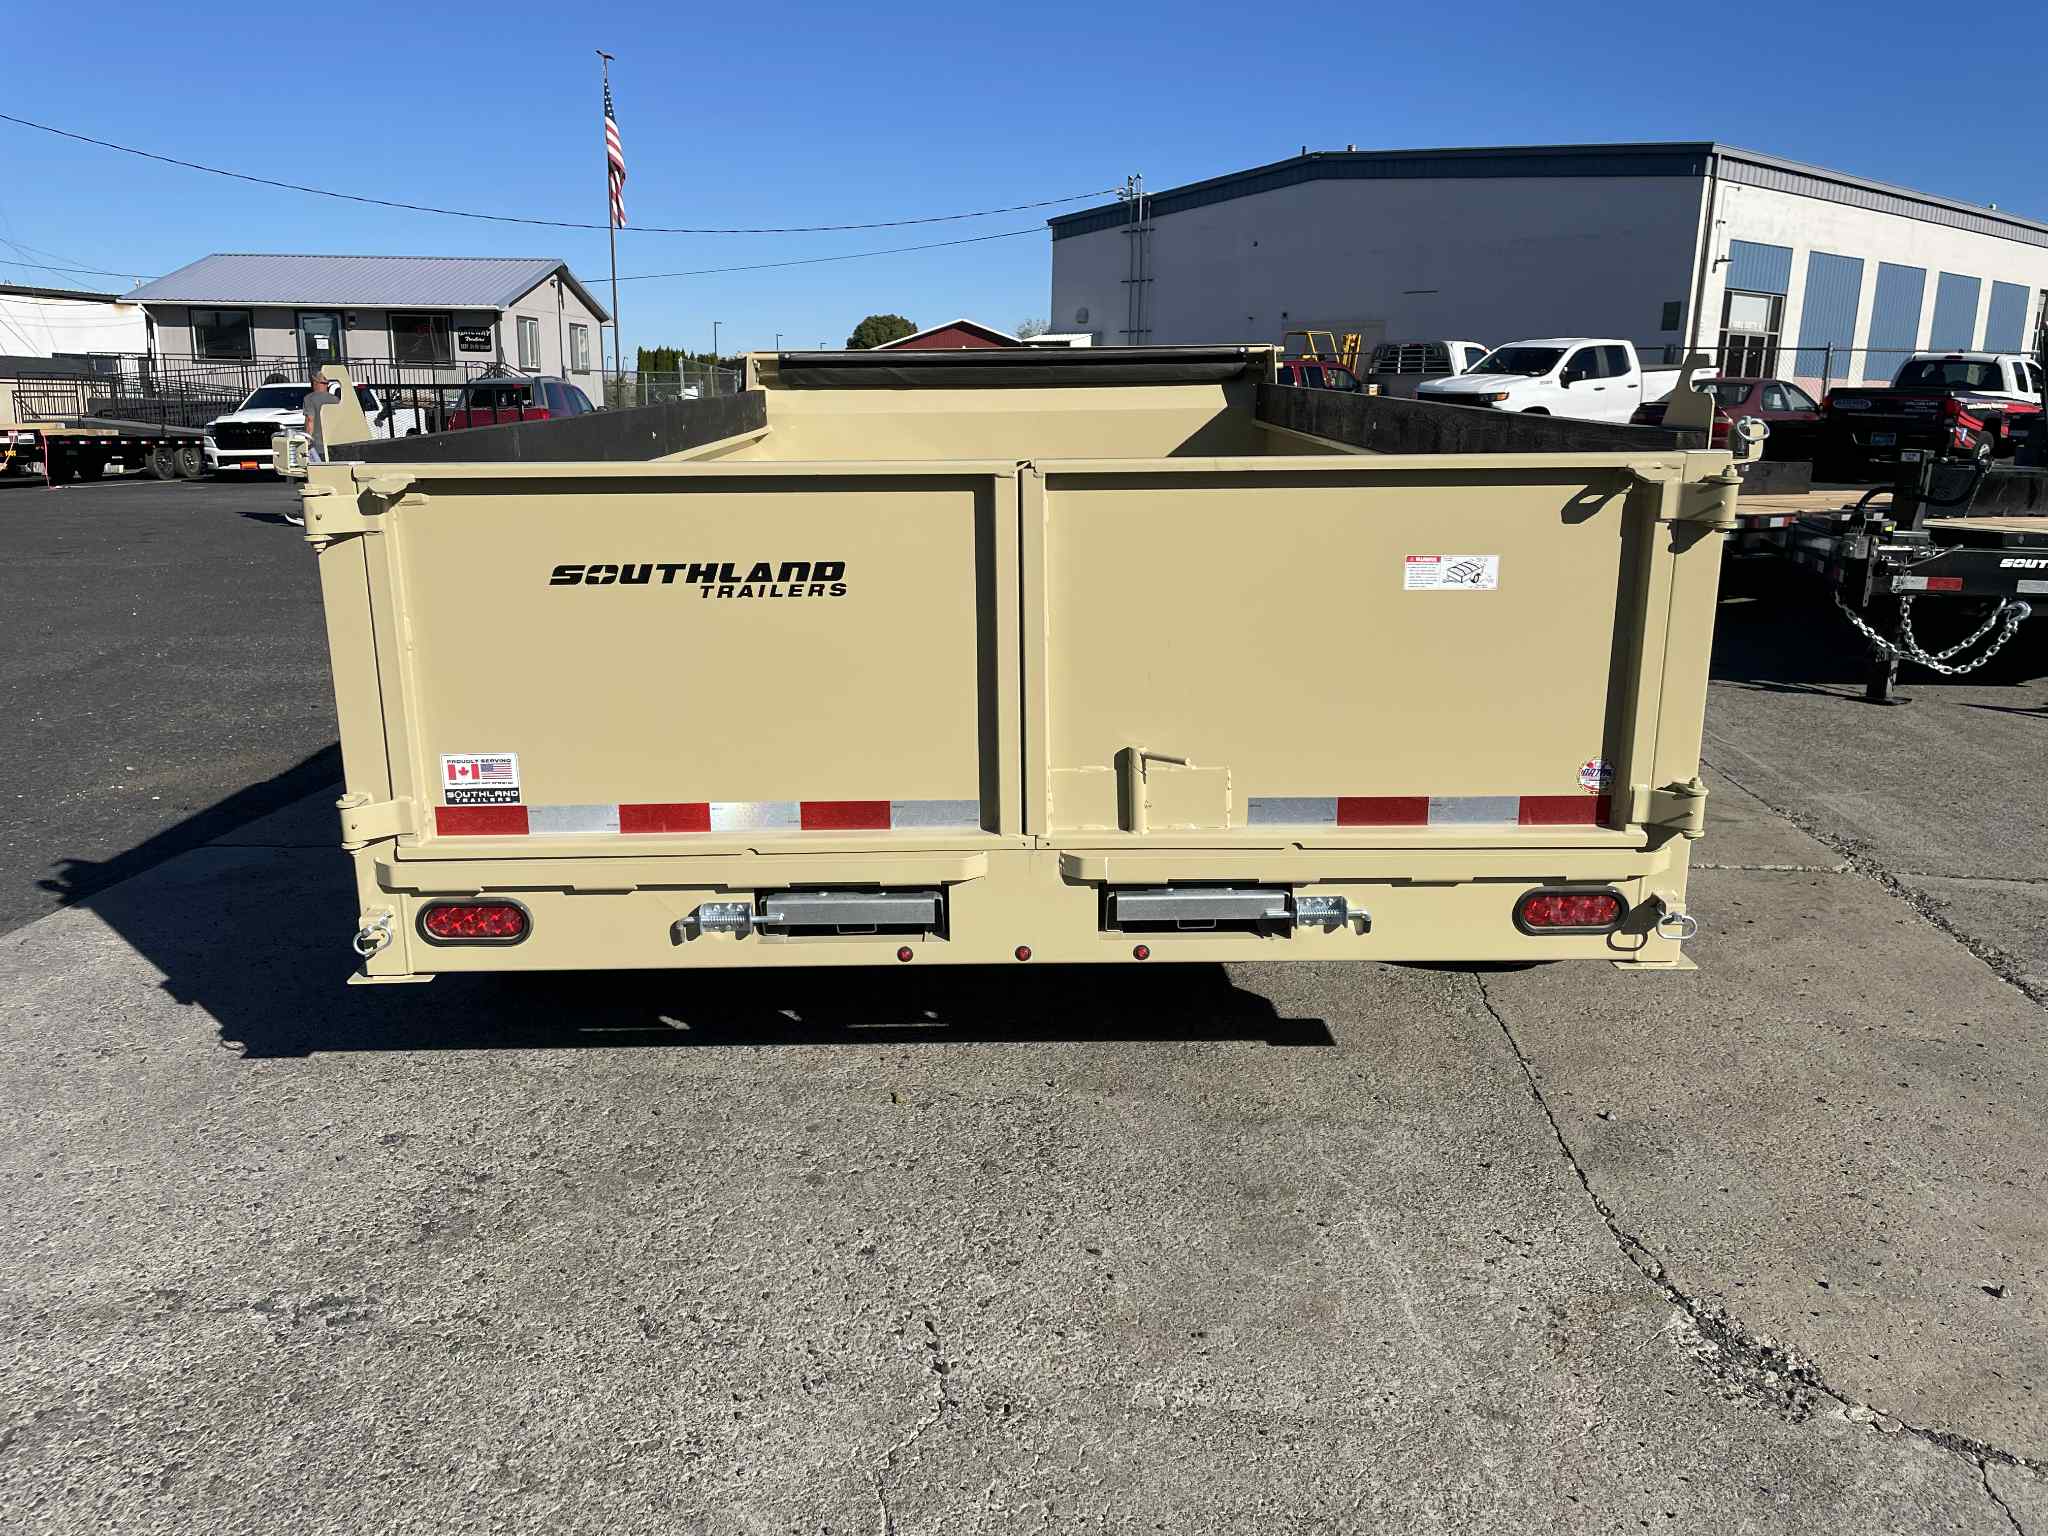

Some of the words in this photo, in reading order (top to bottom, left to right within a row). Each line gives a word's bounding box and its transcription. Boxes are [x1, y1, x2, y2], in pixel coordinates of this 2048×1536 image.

[1999, 558, 2048, 569] SOUT
[549, 561, 846, 585] SOUTHLAND
[699, 583, 847, 599] TRAILERS
[446, 790, 518, 799] SOUTHLAND
